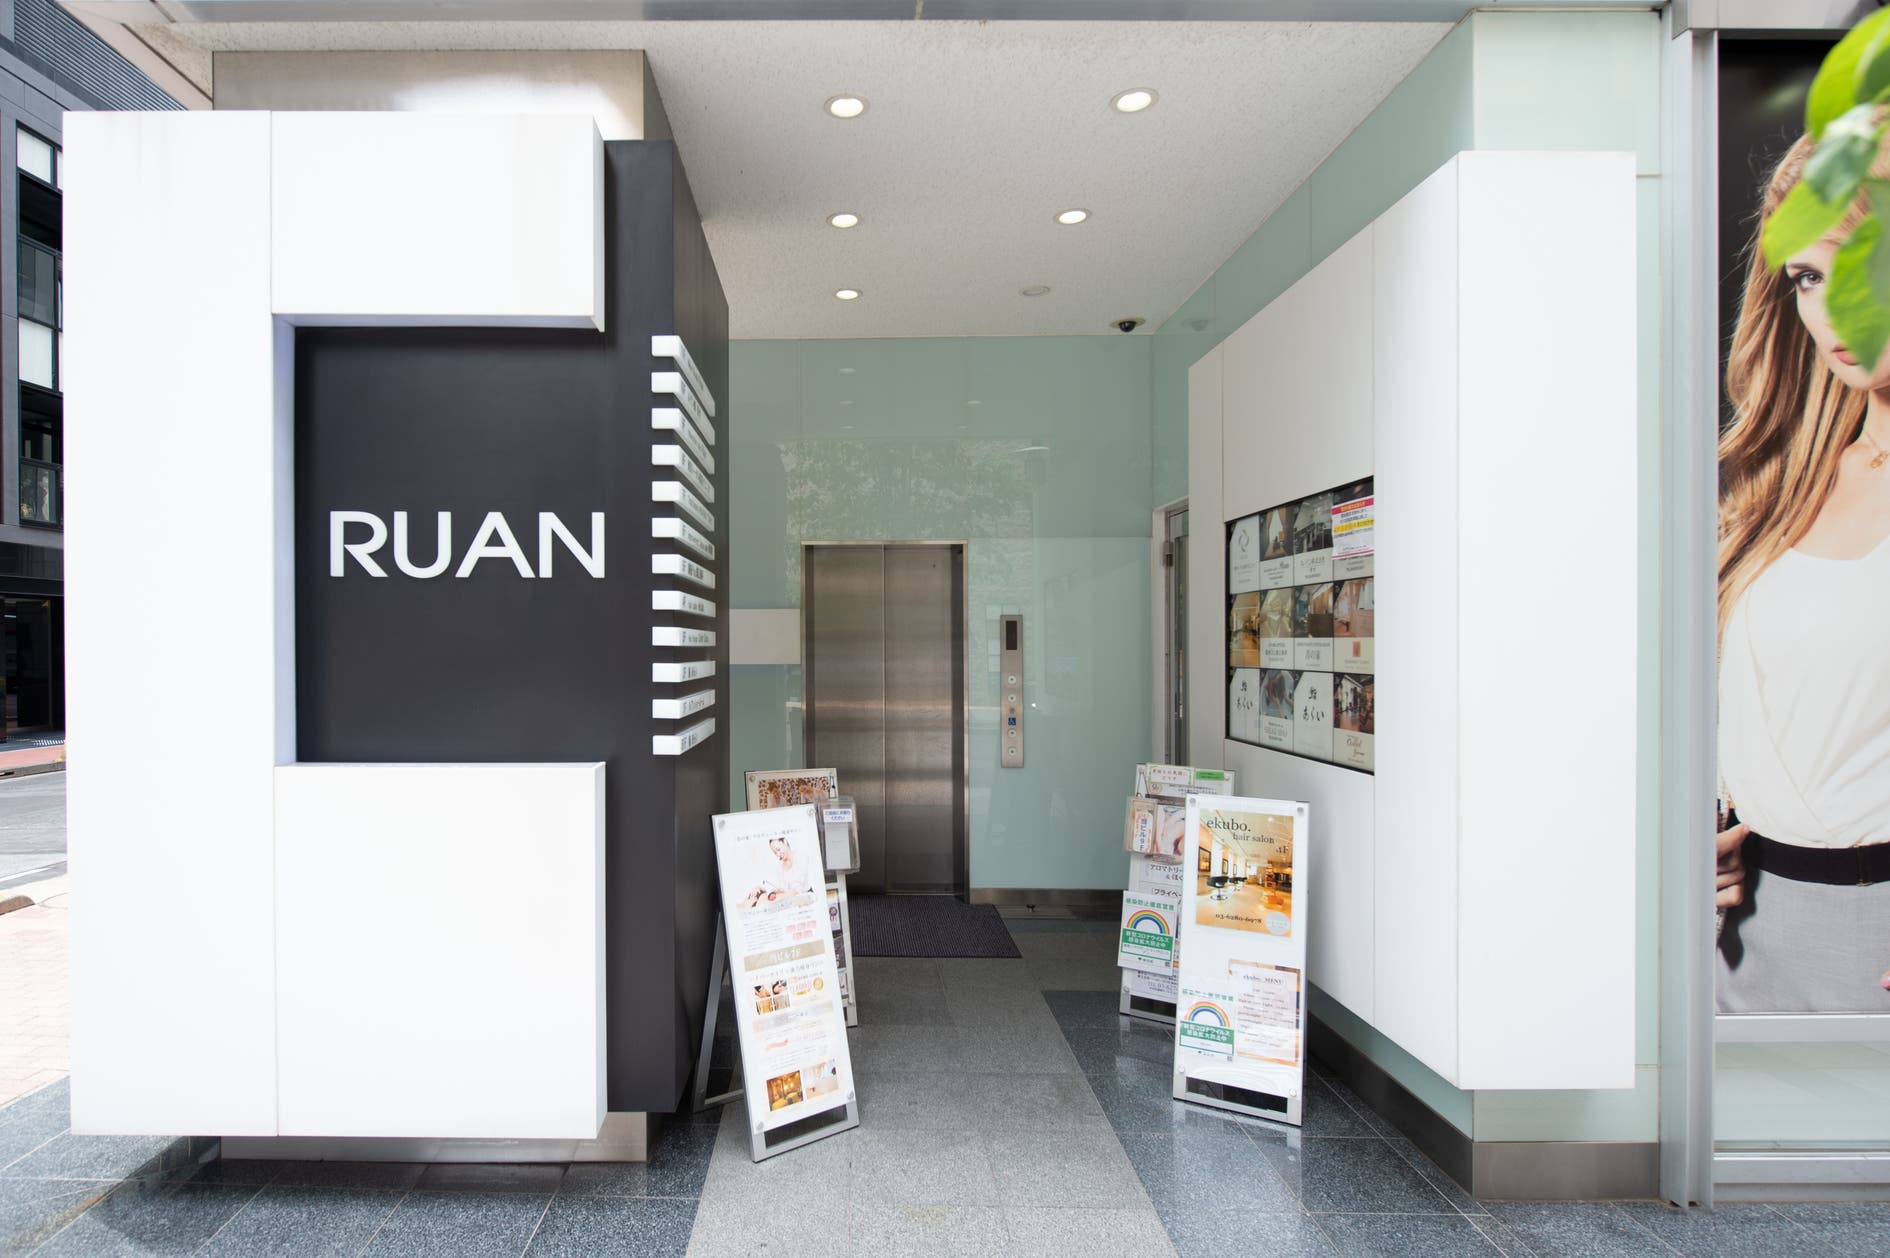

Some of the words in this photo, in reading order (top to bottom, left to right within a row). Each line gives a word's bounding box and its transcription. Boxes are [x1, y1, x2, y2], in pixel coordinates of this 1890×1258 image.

[330, 511, 605, 579] RUAN
[1207, 817, 1251, 832] ekubo.
[1233, 832, 1250, 841] hair
[1252, 835, 1274, 844] salon
